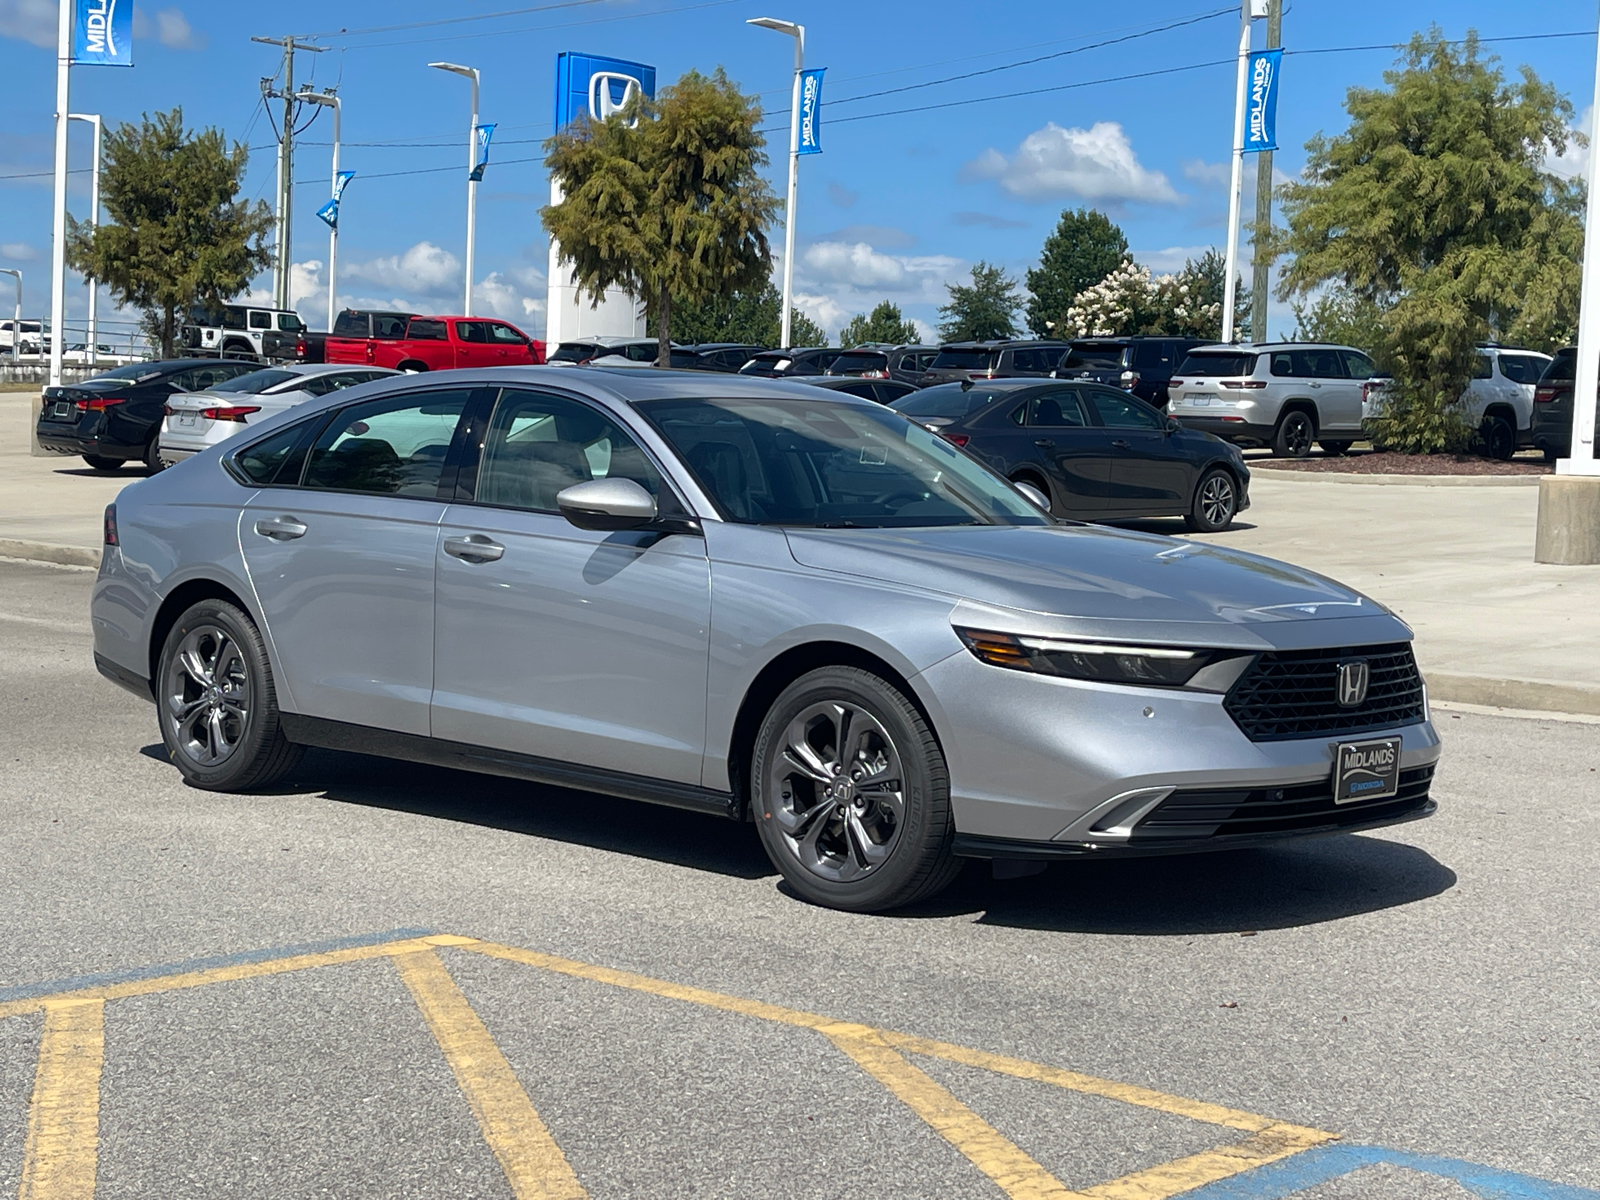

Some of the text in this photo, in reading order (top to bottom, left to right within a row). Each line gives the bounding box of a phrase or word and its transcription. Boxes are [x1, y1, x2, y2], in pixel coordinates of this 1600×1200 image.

[86, 0, 107, 53] MIDL
[802, 75, 814, 147] MIDLANDS
[1250, 57, 1267, 142] MIDLANDS
[1344, 748, 1395, 769] MIDLANDS
